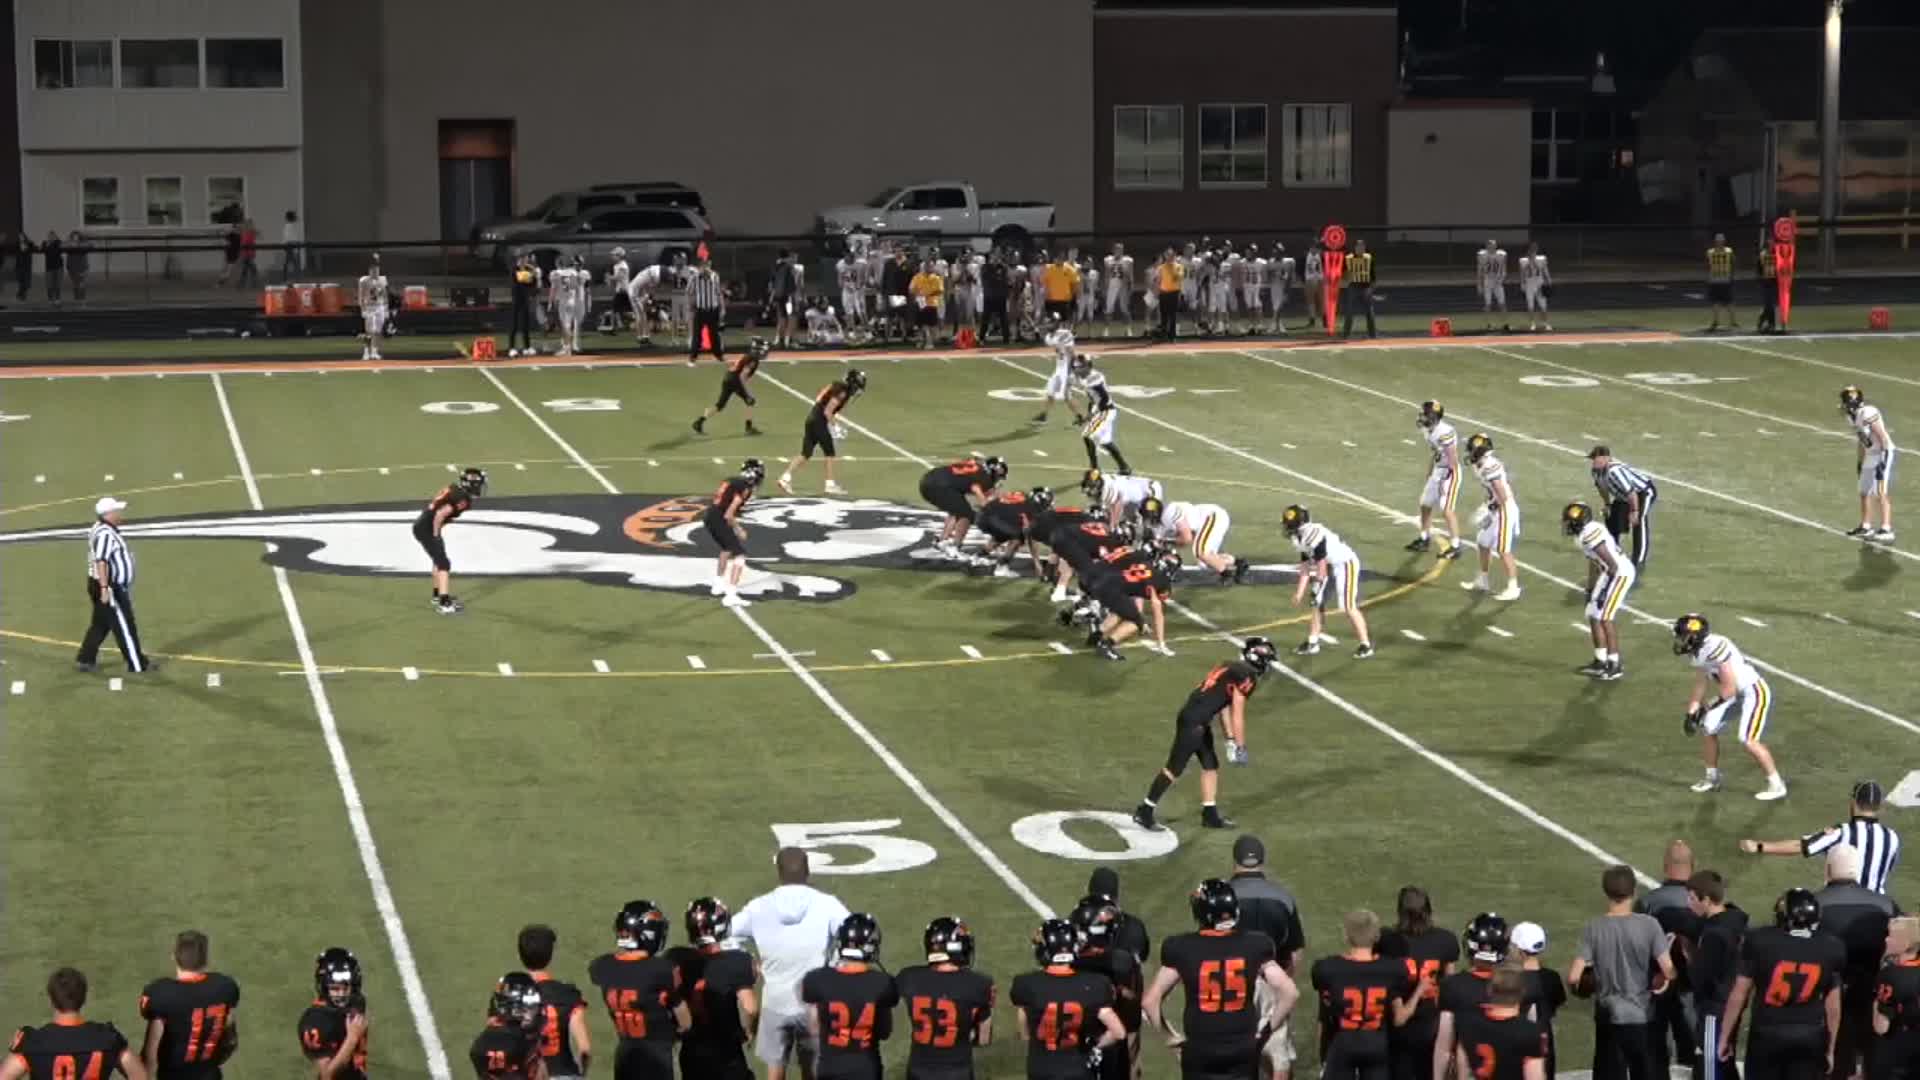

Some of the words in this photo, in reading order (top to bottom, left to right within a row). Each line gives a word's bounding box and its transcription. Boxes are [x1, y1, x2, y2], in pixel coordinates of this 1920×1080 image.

[770, 810, 1180, 875] 50
[1199, 958, 1248, 1013] 65
[1764, 960, 1822, 1008] 67
[184, 1003, 226, 1062] 17
[827, 1001, 876, 1048] 34
[912, 996, 959, 1048] 53
